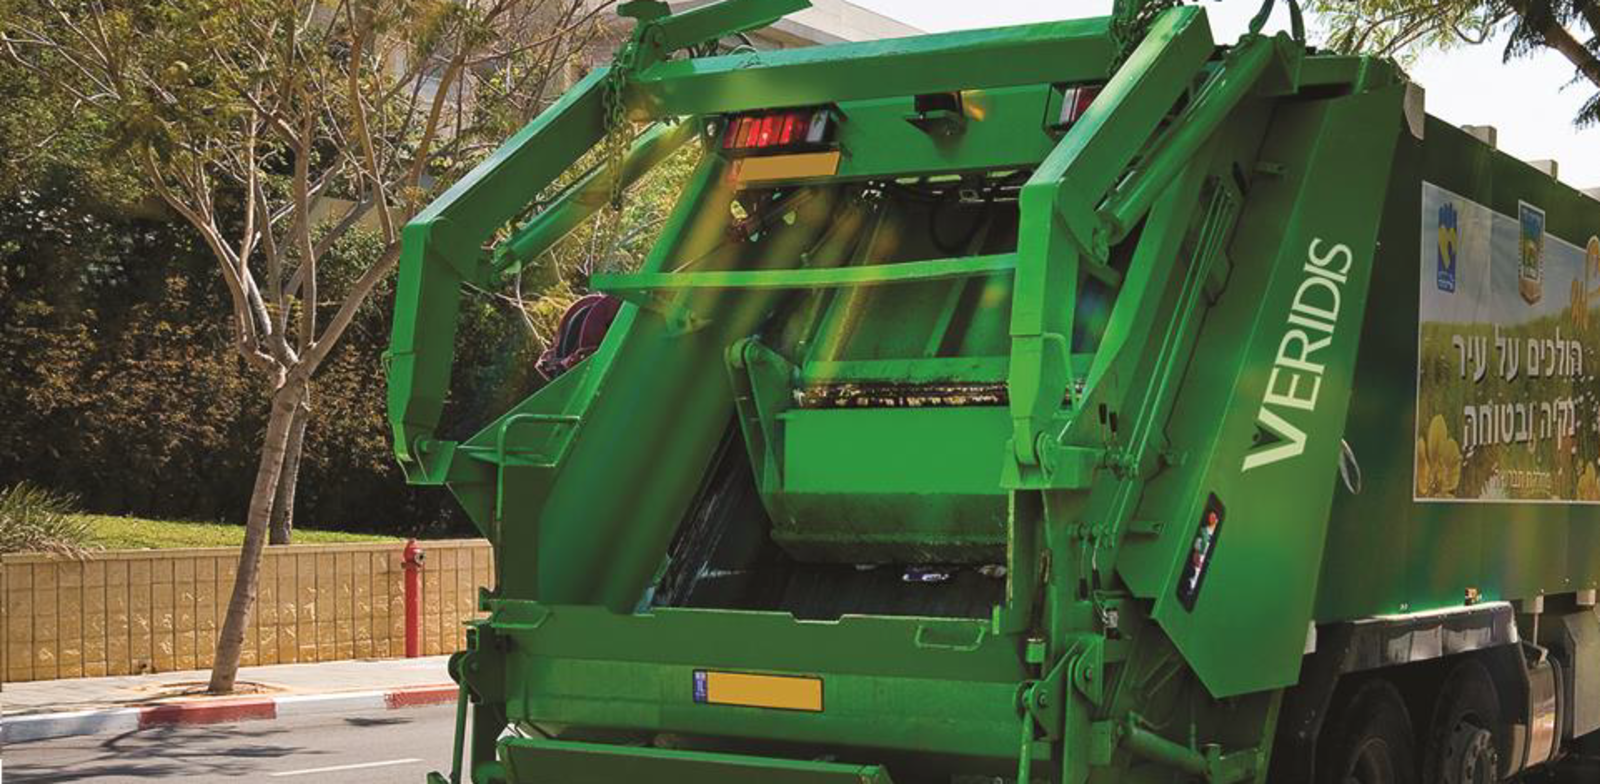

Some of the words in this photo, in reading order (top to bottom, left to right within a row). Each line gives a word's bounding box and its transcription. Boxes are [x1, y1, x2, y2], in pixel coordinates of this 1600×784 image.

[1242, 238, 1353, 472] VERIDIS
[1452, 334, 1487, 381] עיר
[1494, 323, 1519, 381] על
[1527, 326, 1582, 376] הולכים
[1463, 402, 1535, 448] ובטוחה
[1541, 398, 1575, 450] נקיה
